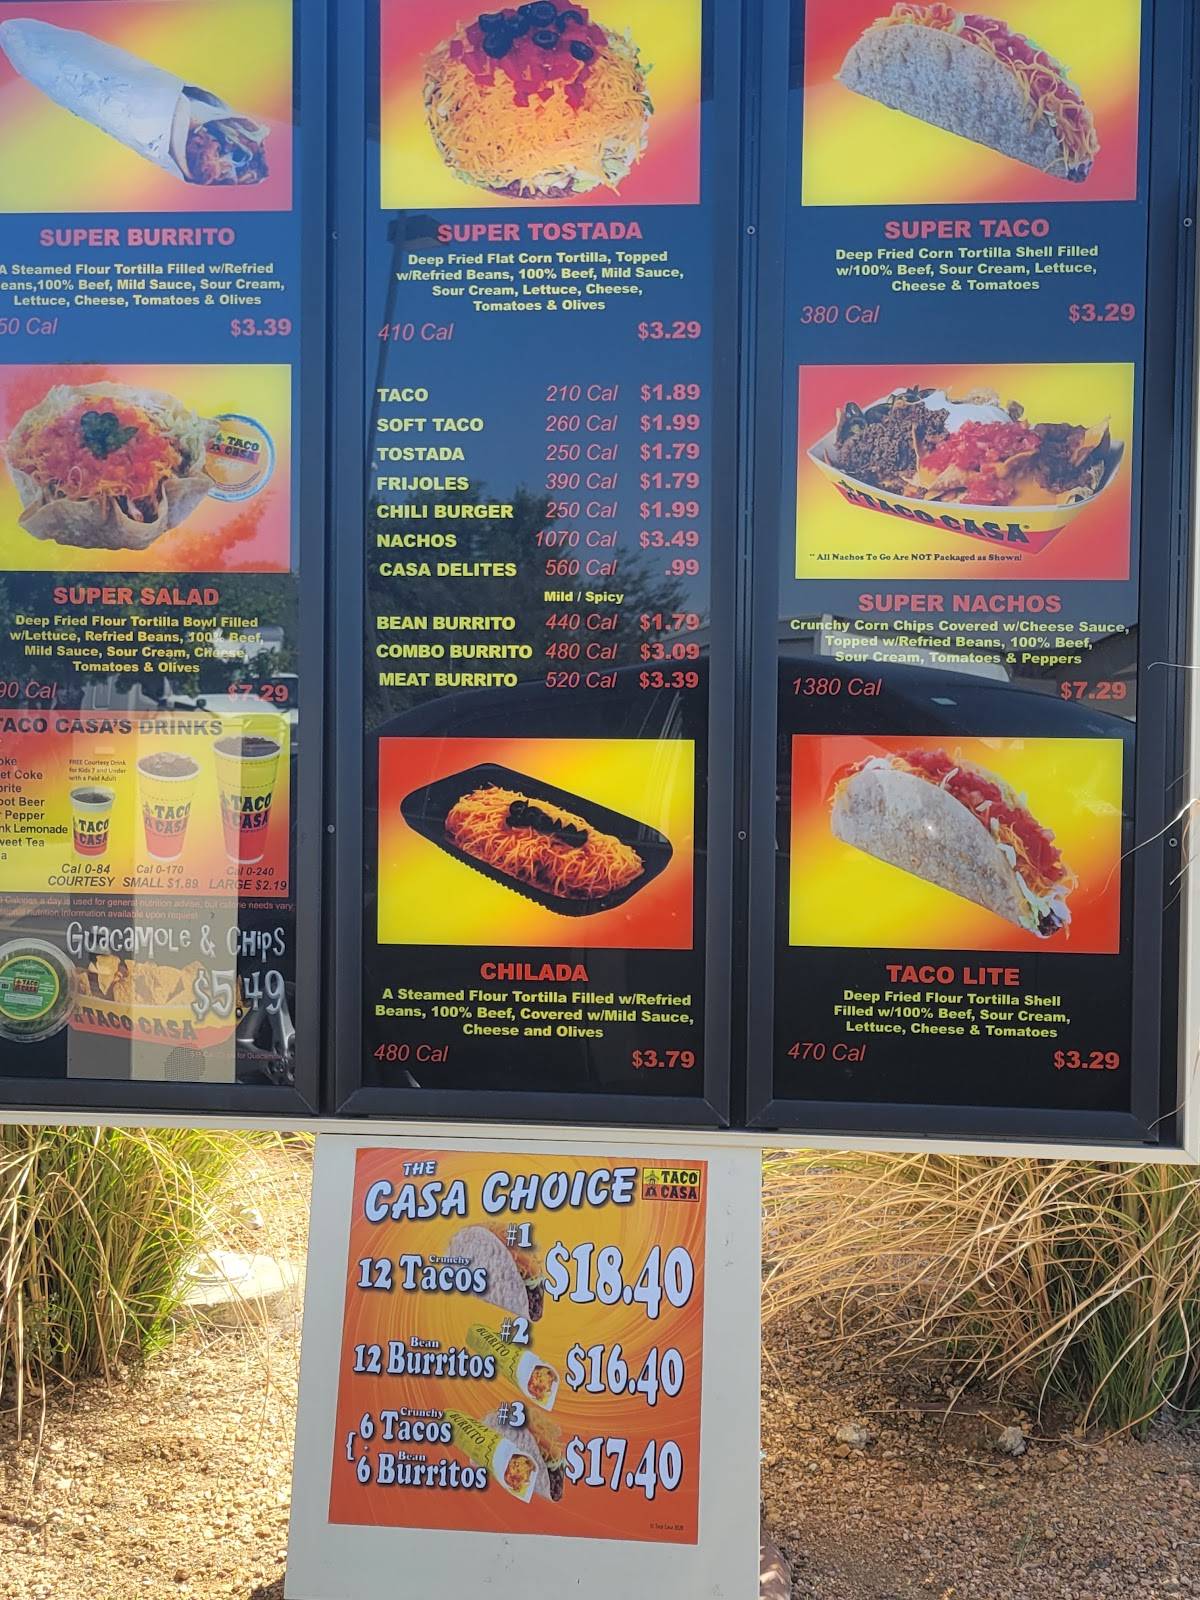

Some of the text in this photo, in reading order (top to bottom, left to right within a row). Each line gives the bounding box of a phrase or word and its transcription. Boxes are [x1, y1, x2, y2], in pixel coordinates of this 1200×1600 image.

[39, 228, 235, 247] SUPER BURRITO
[437, 222, 642, 242] SUPER TOSTADA
[884, 219, 1050, 239] SUPER TACO
[408, 251, 668, 266] Deep Fried Flat Corn Tortilla, Topped
[0, 262, 274, 275] A Steamed Flour Tortilla Filled w/Refried
[892, 279, 1040, 291] Cheese & Tomatoes
[14, 294, 262, 308] Lettuce, Cheese, Tomatoes & Olives
[800, 305, 880, 324] 380 Cal
[1068, 303, 1136, 323] $3.29
[0, 317, 58, 335] 50 Cal
[230, 318, 292, 337] $3.39
[638, 321, 701, 340] $3.29
[377, 388, 429, 402] TACO
[545, 384, 618, 402] 210 Cal
[640, 384, 700, 402] $1.89
[227, 436, 260, 451] TACO
[545, 444, 617, 461] 250 Cal
[640, 443, 700, 461] $1.79
[377, 448, 465, 461] TOSTADA
[377, 505, 513, 518] CHILI BURGER
[545, 502, 617, 518] 250 Cal
[640, 501, 700, 518] $1.99
[856, 490, 935, 523] TACO
[545, 559, 617, 576] 560 Cal
[665, 559, 700, 576] .99
[879, 554, 891, 562] Go
[934, 554, 975, 563] Packaged
[988, 554, 1022, 562] Shown!
[379, 563, 517, 577] CASA DELITES
[54, 587, 219, 606] SUPER SALAD
[544, 591, 574, 602] Mild
[585, 591, 624, 605] Spicy
[858, 594, 1062, 613] SUPER NACHOS
[16, 616, 259, 628] Deep Fried Flour Tortilla Bowl Filled
[377, 616, 516, 630] BEAN BURRITO
[545, 614, 617, 630] 440 Cal
[640, 613, 700, 631] $1.79
[0, 682, 58, 699] 90 Cal
[228, 684, 288, 702] $7.29
[791, 678, 882, 696] 1380 Cal
[1060, 682, 1127, 701] $7.29
[55, 719, 132, 734] CASA'S
[139, 720, 223, 736] DRINKS
[14, 770, 43, 780] Coke
[5, 810, 45, 822] Pepper
[236, 793, 273, 829] TACO CASA
[14, 825, 68, 834] Lemonade
[79, 819, 110, 832] TACO
[61, 864, 111, 875] Cal 0-84
[48, 876, 115, 888] COURTESY
[122, 877, 164, 889] SMALL
[208, 879, 287, 891] LARGE $2.19
[201, 924, 216, 958] &
[480, 962, 589, 982] CHILADA
[886, 965, 1020, 986] TACO LITE
[84, 1007, 198, 1041] TACO CASA
[374, 1044, 449, 1062] 480 Cal
[632, 1050, 695, 1069] $3.79
[788, 1042, 866, 1062] 470 Cal
[1053, 1050, 1120, 1070] $3.29
[402, 1161, 437, 1177] THE
[365, 1166, 638, 1223] CASA CHOICE
[660, 1170, 699, 1201] TACO CASA
[506, 1222, 533, 1248] #1
[428, 1254, 471, 1266] Crunchy
[358, 1254, 487, 1294] 12 Tacos
[544, 1241, 694, 1320] $18.40
[500, 1317, 529, 1345] #2
[410, 1336, 440, 1349] Bean
[476, 1327, 510, 1357] BURRITO
[353, 1340, 496, 1380] 12 Burritos
[565, 1343, 685, 1406] $16.40
[399, 1406, 445, 1419] Crunchy
[498, 1401, 526, 1427] #3
[360, 1413, 374, 1439] 6
[381, 1409, 452, 1443] Tacos
[449, 1413, 485, 1445] BURRITO
[398, 1450, 426, 1462] Bean
[356, 1452, 487, 1490] 6 Burritos
[565, 1435, 685, 1501] $17.40
